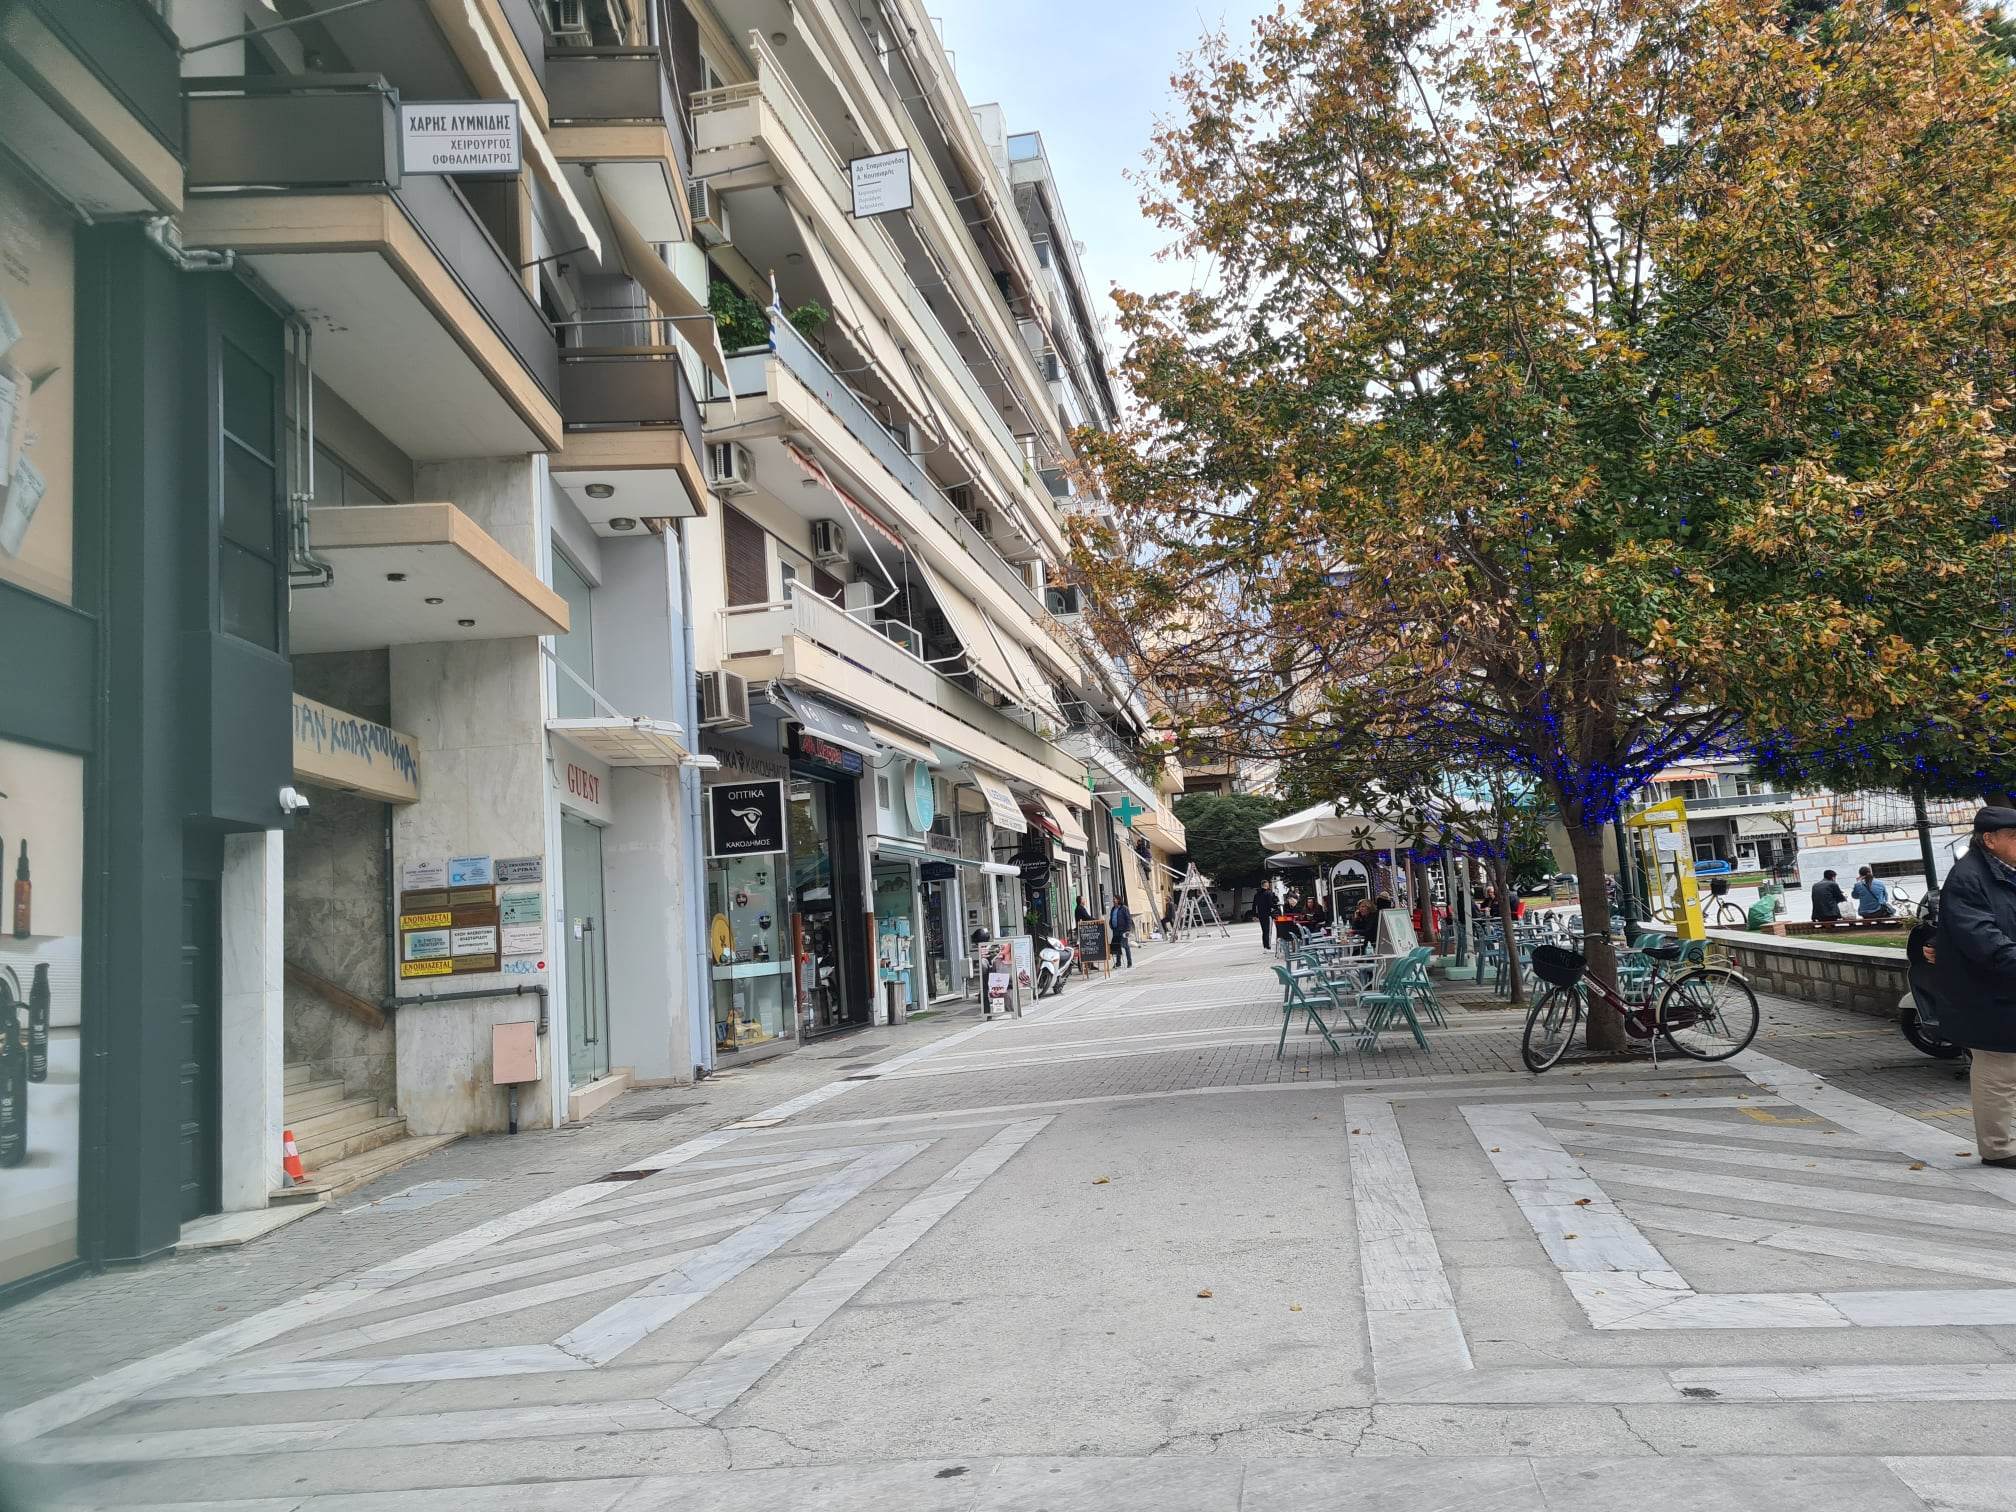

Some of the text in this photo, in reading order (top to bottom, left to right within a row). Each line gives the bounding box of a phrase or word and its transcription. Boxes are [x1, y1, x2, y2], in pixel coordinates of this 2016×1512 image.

[410, 115, 511, 132] ΧΑΡΗΣ ΛΥΜΝΙΔΗΣ
[451, 138, 511, 151] ΧΕΙΡΟΥΡΓΟΣ
[432, 153, 513, 165] ΟΦΘΑΛΜΙΑΤΡΟΣ
[293, 704, 327, 753] ΤΑΝ
[568, 763, 599, 804] GUEST
[728, 789, 764, 800] ΟΠΤΙΚΑ
[726, 838, 771, 849] ΚΑΚΟΔΗΜΟΣ
[404, 913, 449, 924] ΕΝΟΙΚΙΑΖΕΤΑΙ
[404, 960, 450, 971] ΕΝΟΙΚΙΑΖΕΤΑΙ
